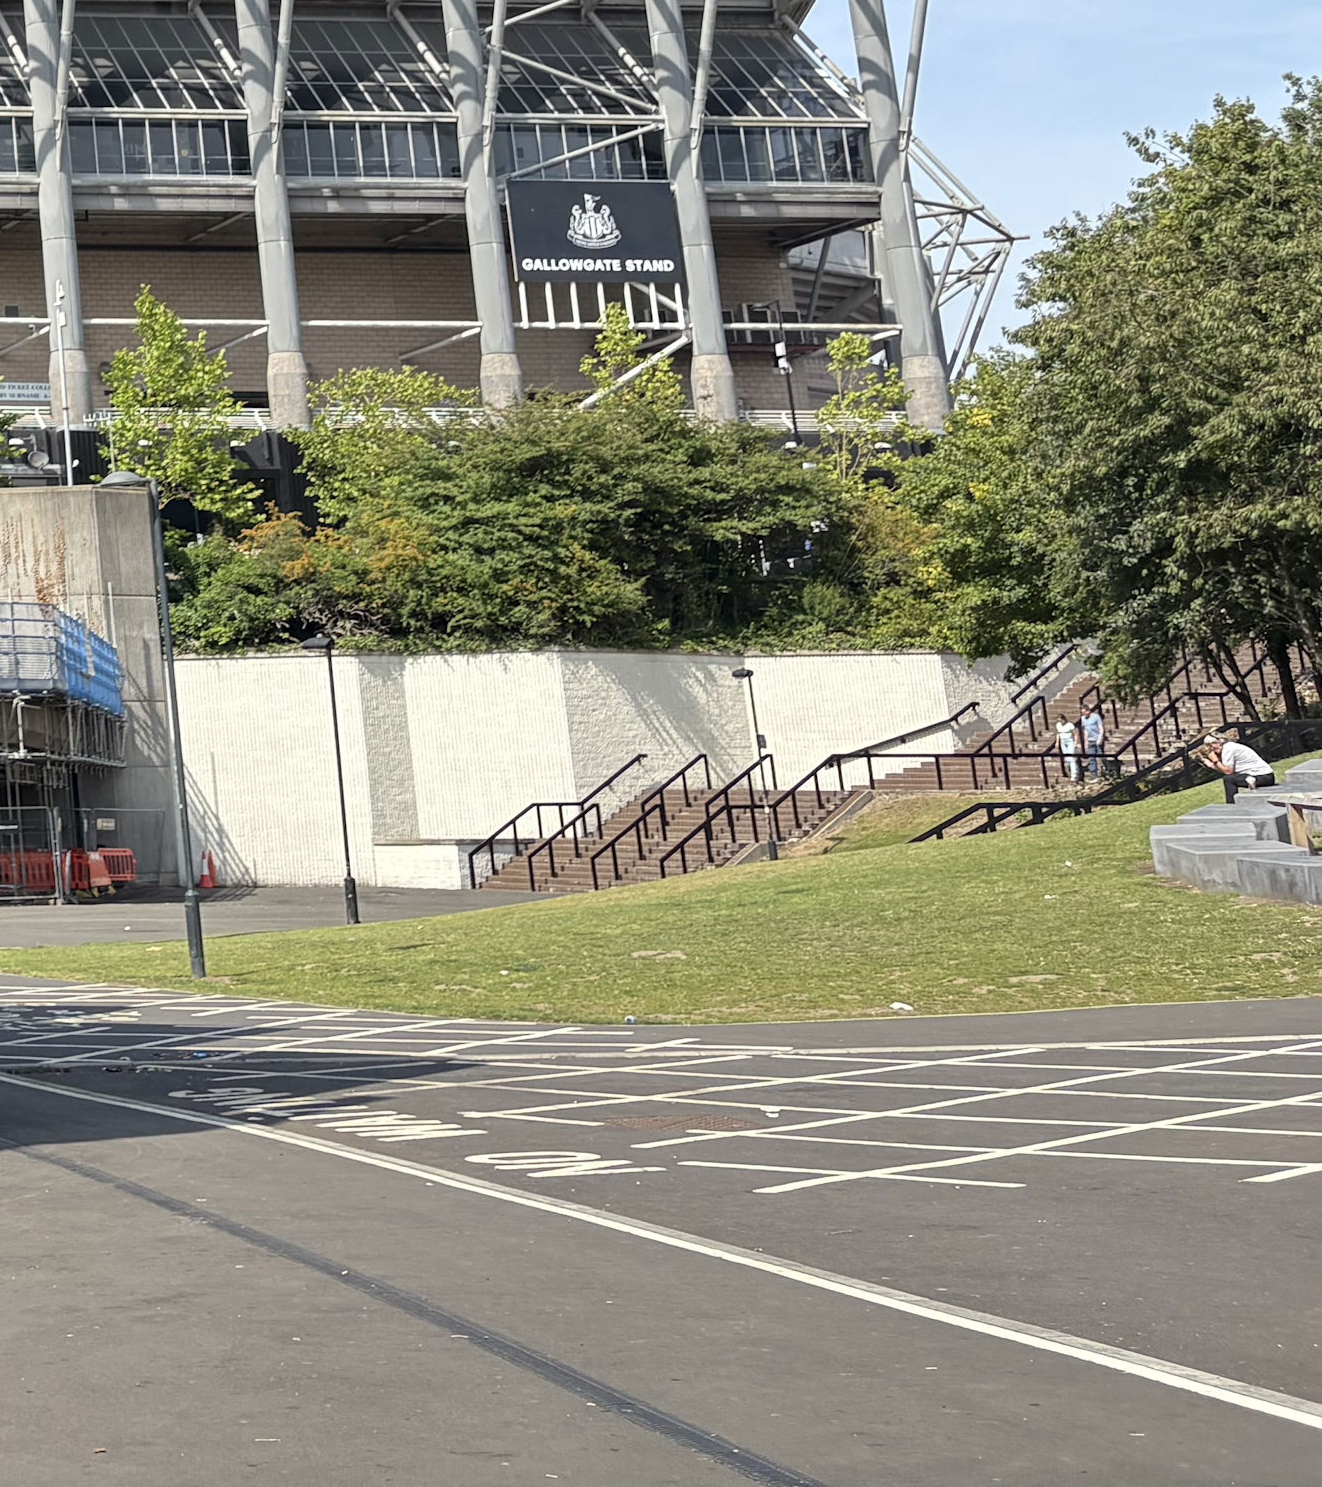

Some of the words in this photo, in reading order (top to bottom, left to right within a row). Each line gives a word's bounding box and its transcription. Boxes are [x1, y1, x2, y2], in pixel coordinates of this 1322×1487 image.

[521, 257, 622, 272] GALLOWGATE
[625, 258, 675, 273] STAND
[463, 1150, 667, 1179] NO
